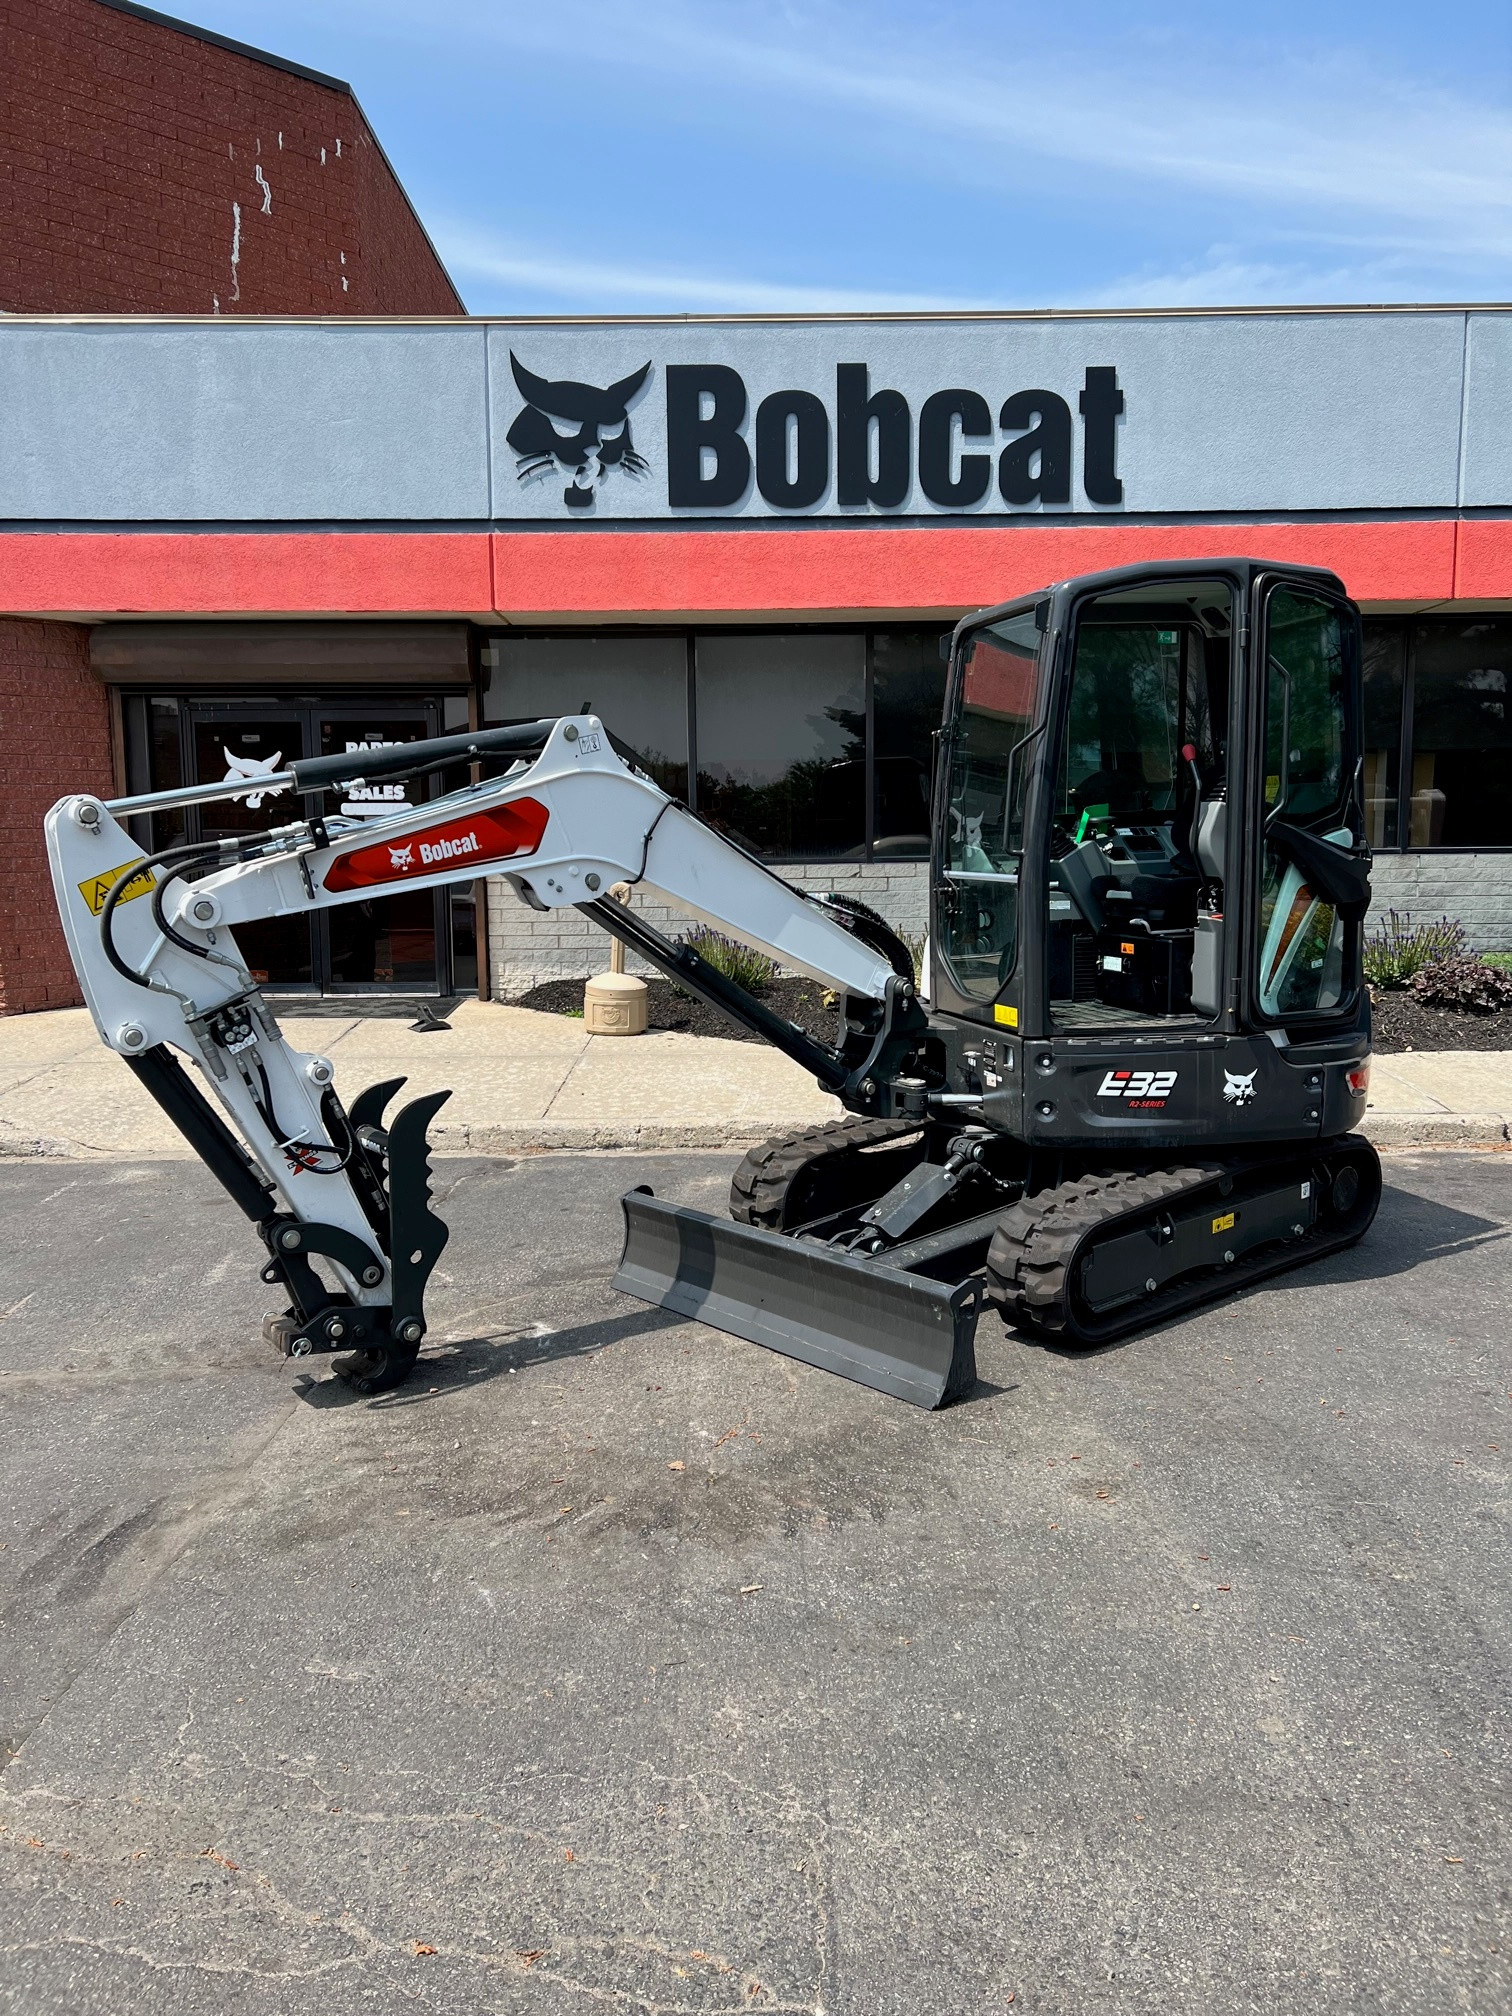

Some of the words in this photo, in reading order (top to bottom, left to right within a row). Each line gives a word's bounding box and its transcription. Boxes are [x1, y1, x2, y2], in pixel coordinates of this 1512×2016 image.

[666, 362, 1124, 508] Bobcat
[347, 785, 405, 800] SALES
[419, 832, 479, 864] Bobcat
[1096, 1071, 1178, 1097] E32
[1128, 1100, 1167, 1108] R2-SERIES
